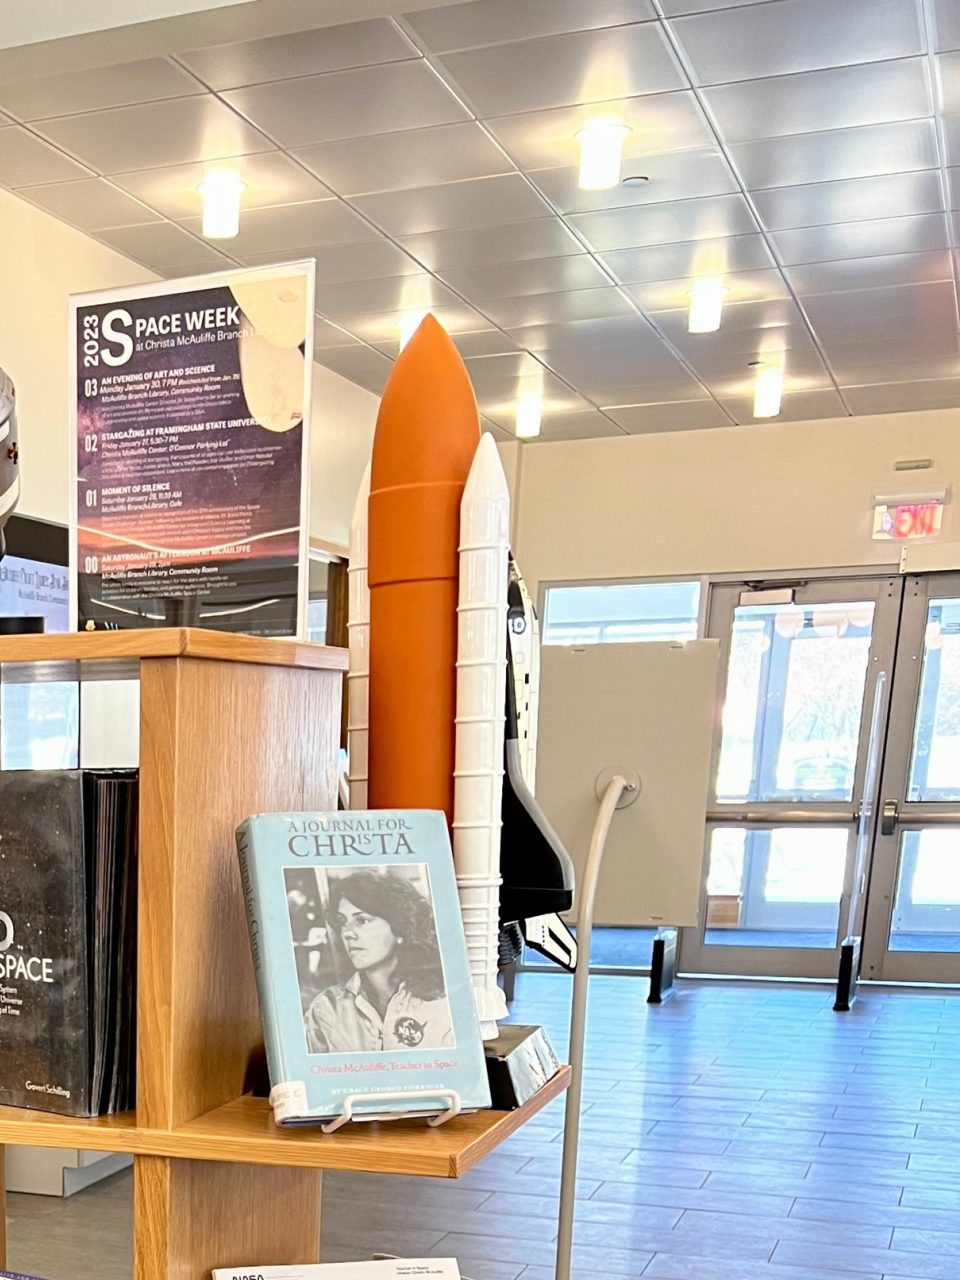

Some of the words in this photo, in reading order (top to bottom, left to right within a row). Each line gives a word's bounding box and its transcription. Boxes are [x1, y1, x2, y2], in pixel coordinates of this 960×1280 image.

[184, 305, 240, 331] WEEK
[84, 314, 99, 367] 2023
[135, 341, 144, 351] at
[145, 338, 175, 350] Christa
[176, 331, 215, 346] McAuliffe
[217, 326, 249, 341] Branch
[101, 377, 111, 385] AN
[112, 373, 143, 384] EVENING
[144, 371, 153, 380] OF
[153, 369, 168, 379] ART
[168, 367, 184, 377] AND
[185, 364, 215, 375] SCIENCE
[84, 378, 98, 397] 03
[124, 381, 150, 392] January
[101, 428, 145, 441] STARGAZING
[145, 428, 154, 437] AT
[155, 423, 204, 436] FRAMINGHAM
[205, 420, 227, 431] STATE
[84, 434, 98, 452] 02
[85, 489, 97, 507] 01
[101, 485, 131, 496] MOMENT
[132, 484, 141, 493] OF
[142, 482, 170, 492] SILENCE
[84, 555, 98, 574] 00
[101, 554, 112, 562] AN
[288, 820, 298, 833] A
[302, 819, 374, 834] JOURNAL
[377, 817, 414, 831] FOR
[288, 832, 416, 858] CHRISTA
[310, 1064, 342, 1075] Christa
[390, 1060, 423, 1071] Teacher
[424, 1060, 432, 1069] in
[433, 1059, 458, 1071] Space
